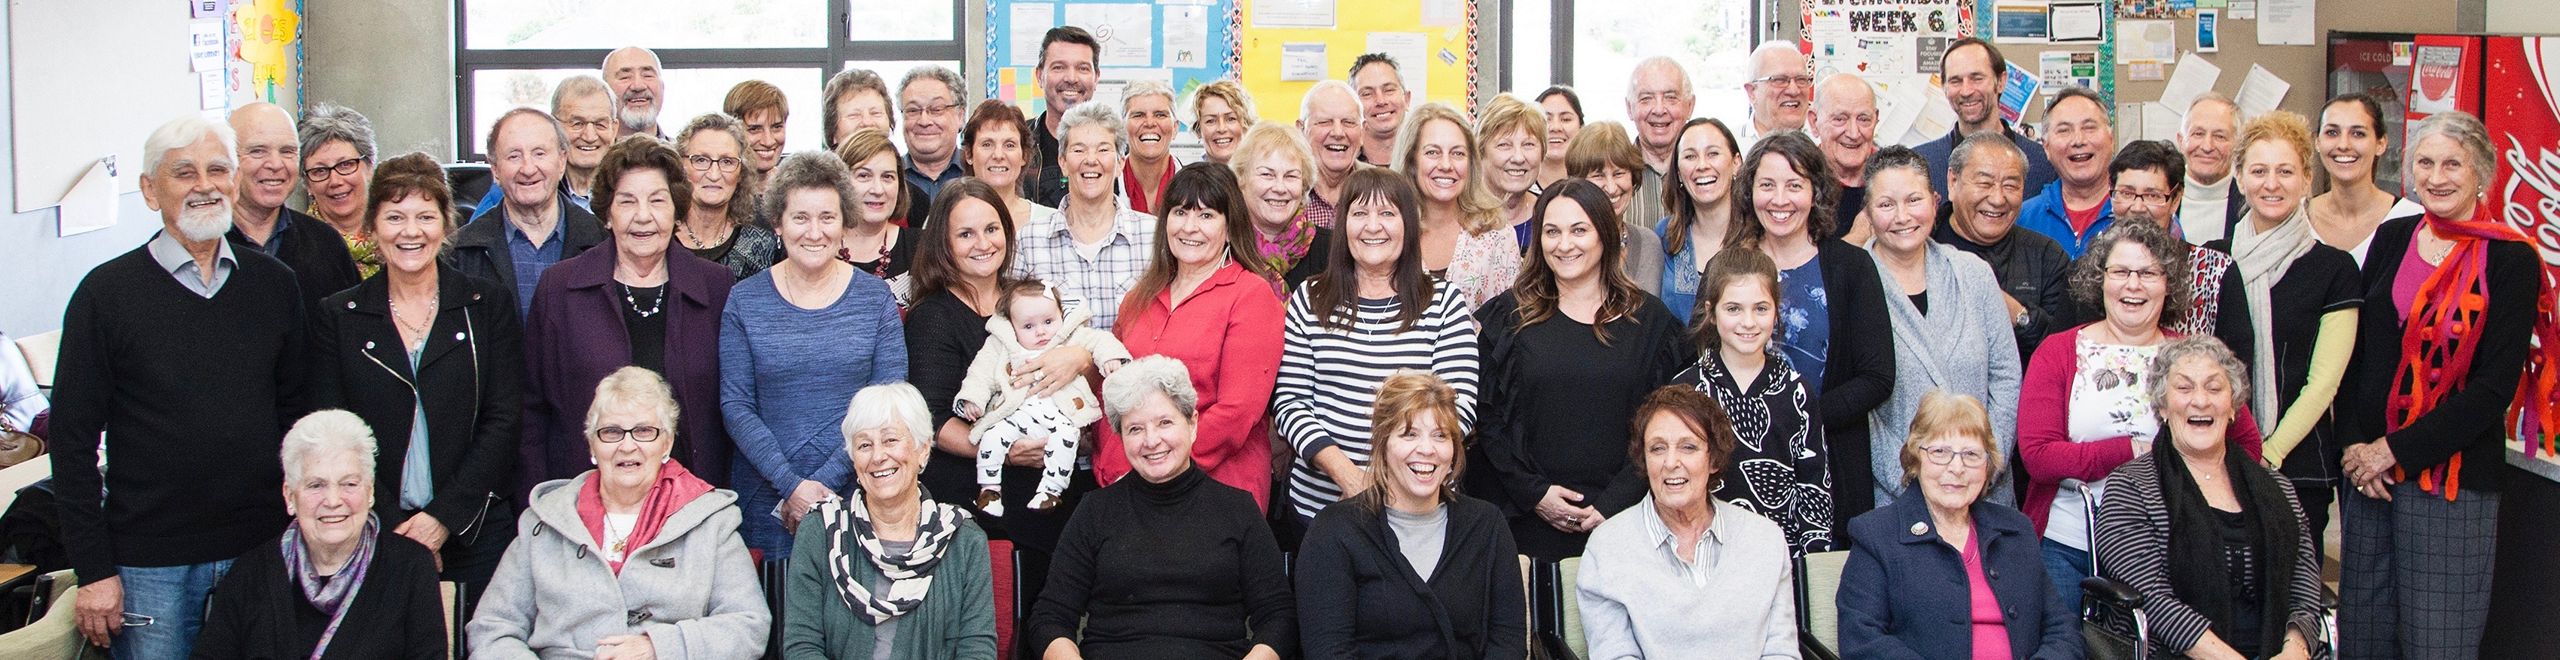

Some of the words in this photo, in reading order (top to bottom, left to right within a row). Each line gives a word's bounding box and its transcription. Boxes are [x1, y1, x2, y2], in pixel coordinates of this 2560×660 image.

[1849, 10, 1917, 32] WEEK
[1928, 10, 1945, 32] 6
[2359, 52, 2370, 62] ICE
[2372, 52, 2391, 62] COLD
